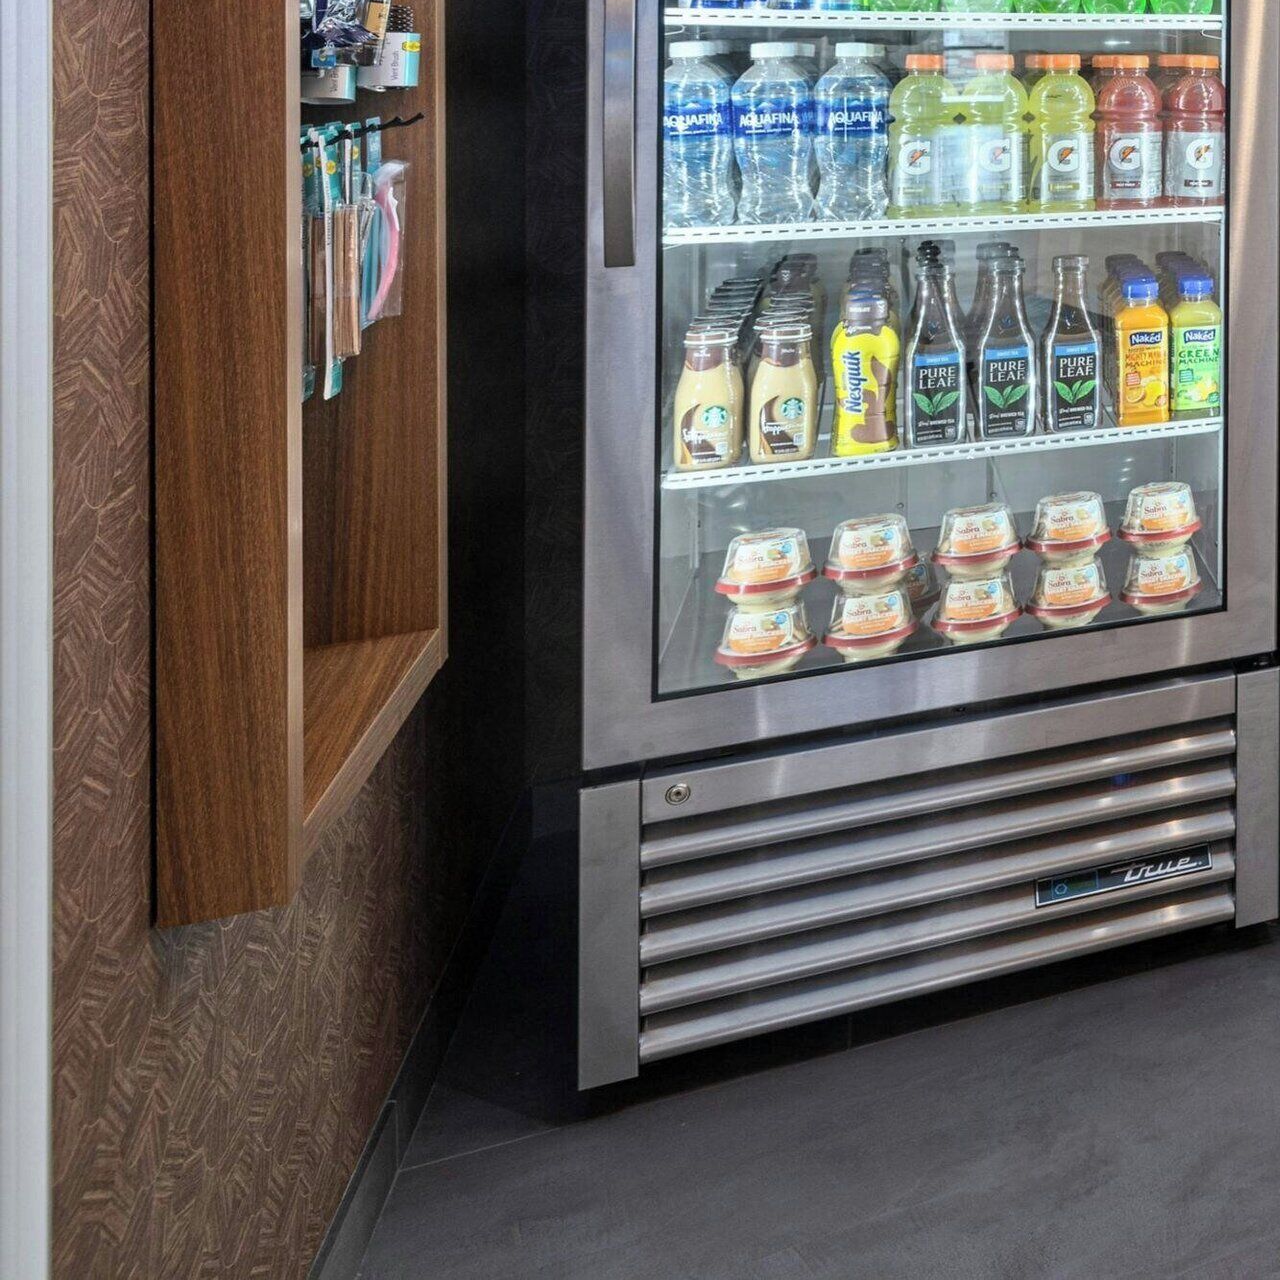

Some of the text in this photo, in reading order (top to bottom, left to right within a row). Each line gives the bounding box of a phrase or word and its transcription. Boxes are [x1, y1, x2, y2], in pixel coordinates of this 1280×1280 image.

[739, 111, 798, 128] AQUAFINA
[989, 359, 1026, 372] PURE
[1059, 355, 1094, 368] PURE
[919, 366, 956, 379] PURE
[843, 350, 867, 414] Nesquik
